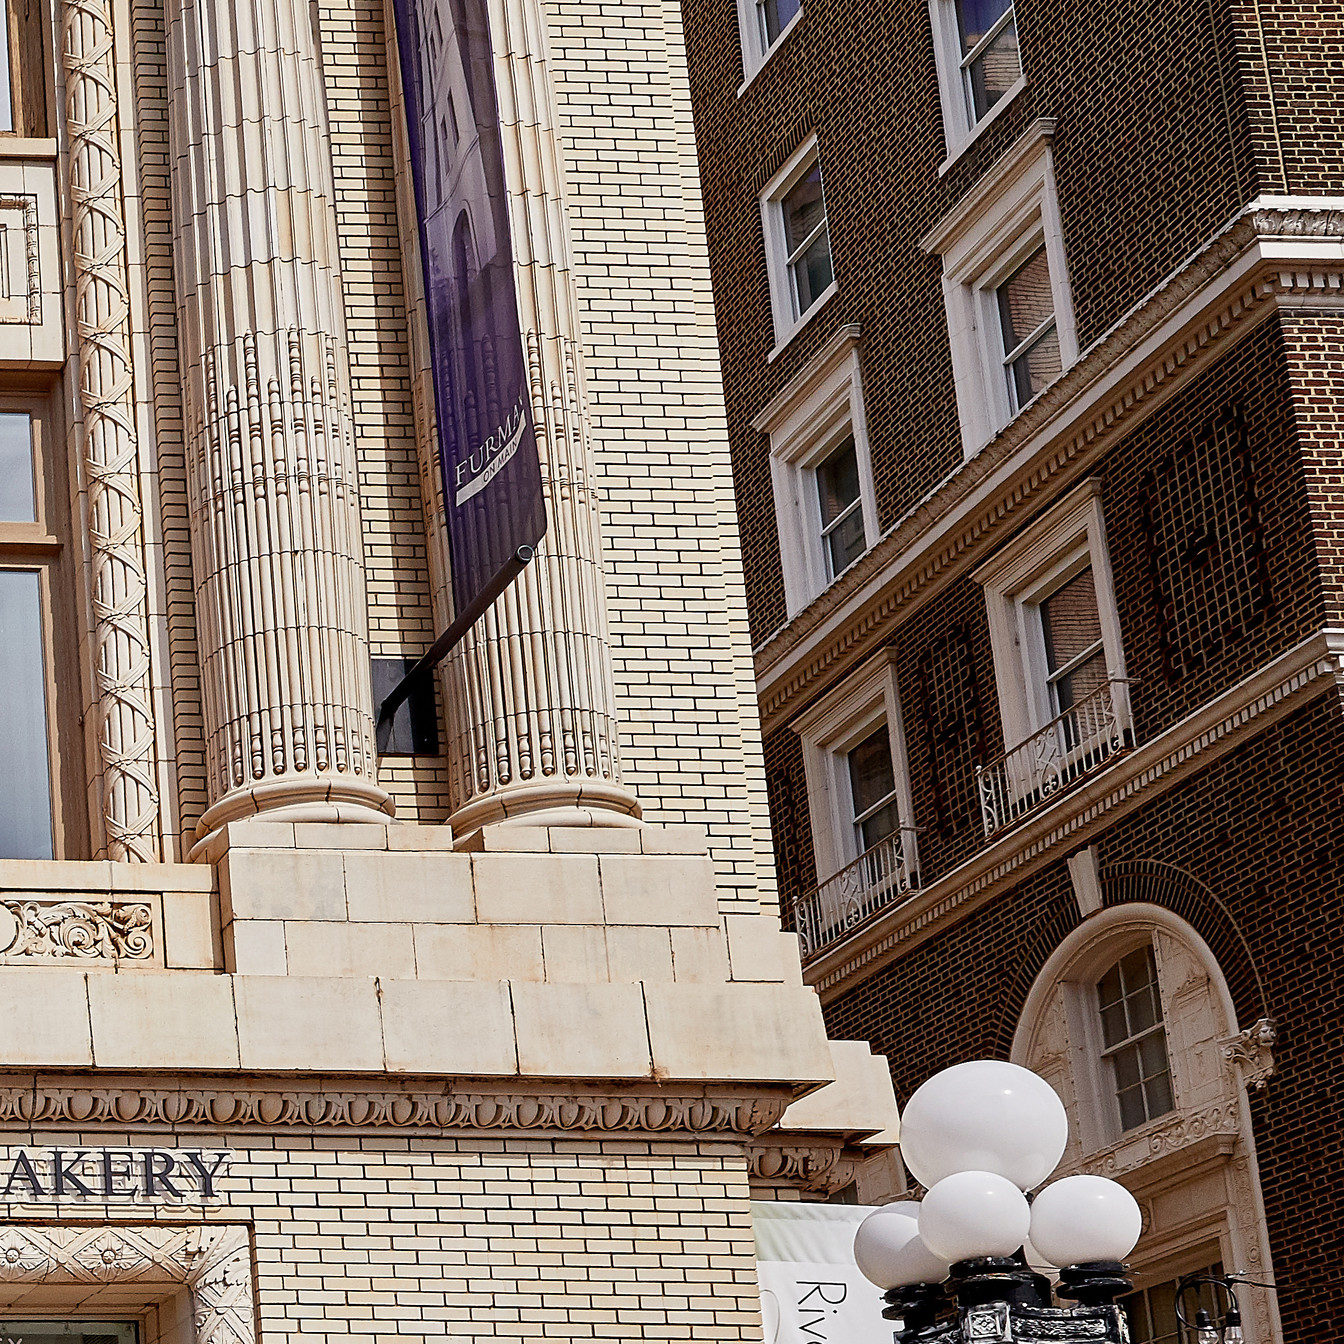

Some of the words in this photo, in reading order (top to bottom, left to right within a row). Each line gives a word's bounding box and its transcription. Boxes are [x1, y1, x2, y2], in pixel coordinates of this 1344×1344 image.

[455, 396, 523, 487] FURMA
[483, 462, 496, 482] ON
[497, 437, 518, 469] MAIN
